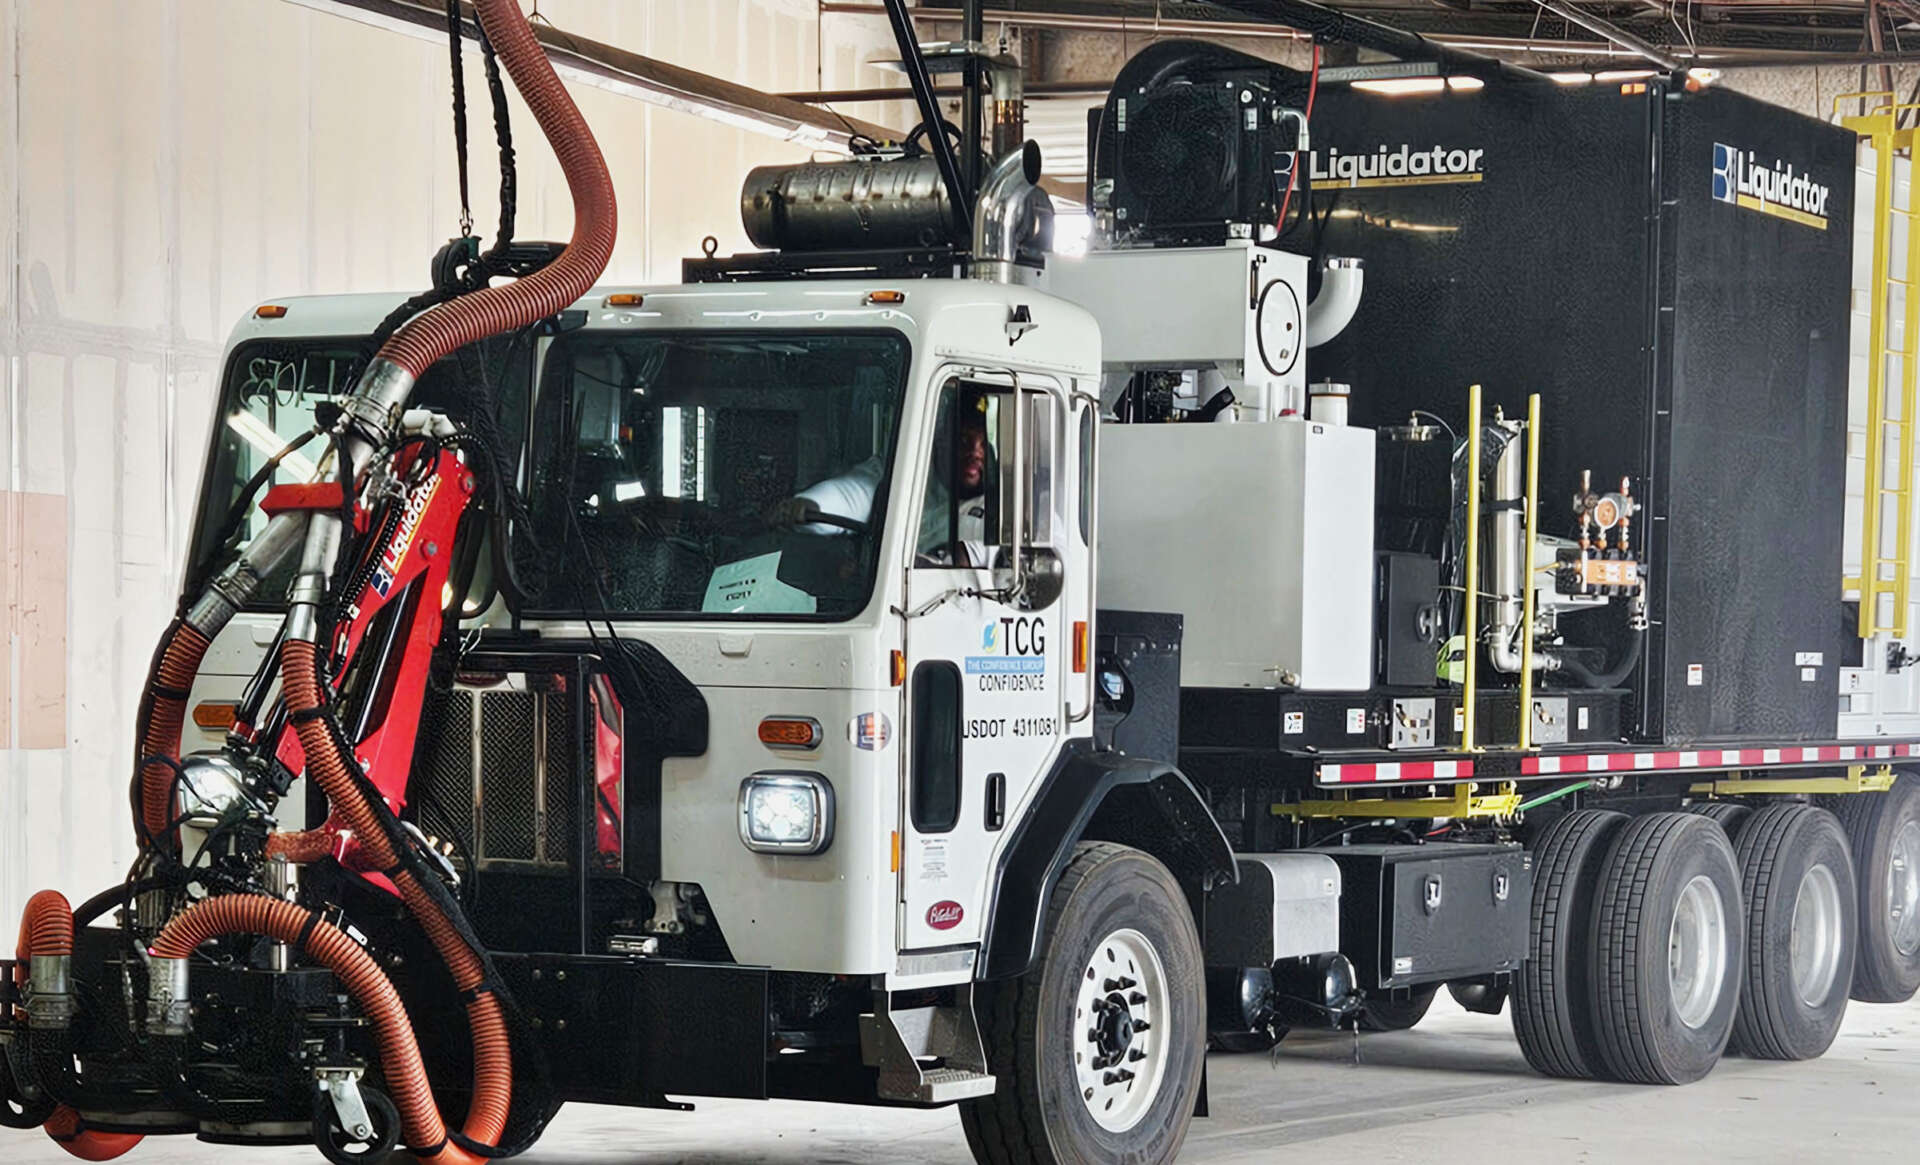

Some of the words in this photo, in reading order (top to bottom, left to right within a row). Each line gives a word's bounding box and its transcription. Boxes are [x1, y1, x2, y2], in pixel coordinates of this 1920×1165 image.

[1310, 144, 1484, 188] Liquidator
[1738, 151, 1828, 215] Liquidator
[1000, 617, 1045, 656] TCG
[979, 674, 1044, 692] CONFIDENCE
[962, 718, 1006, 739] USDOT
